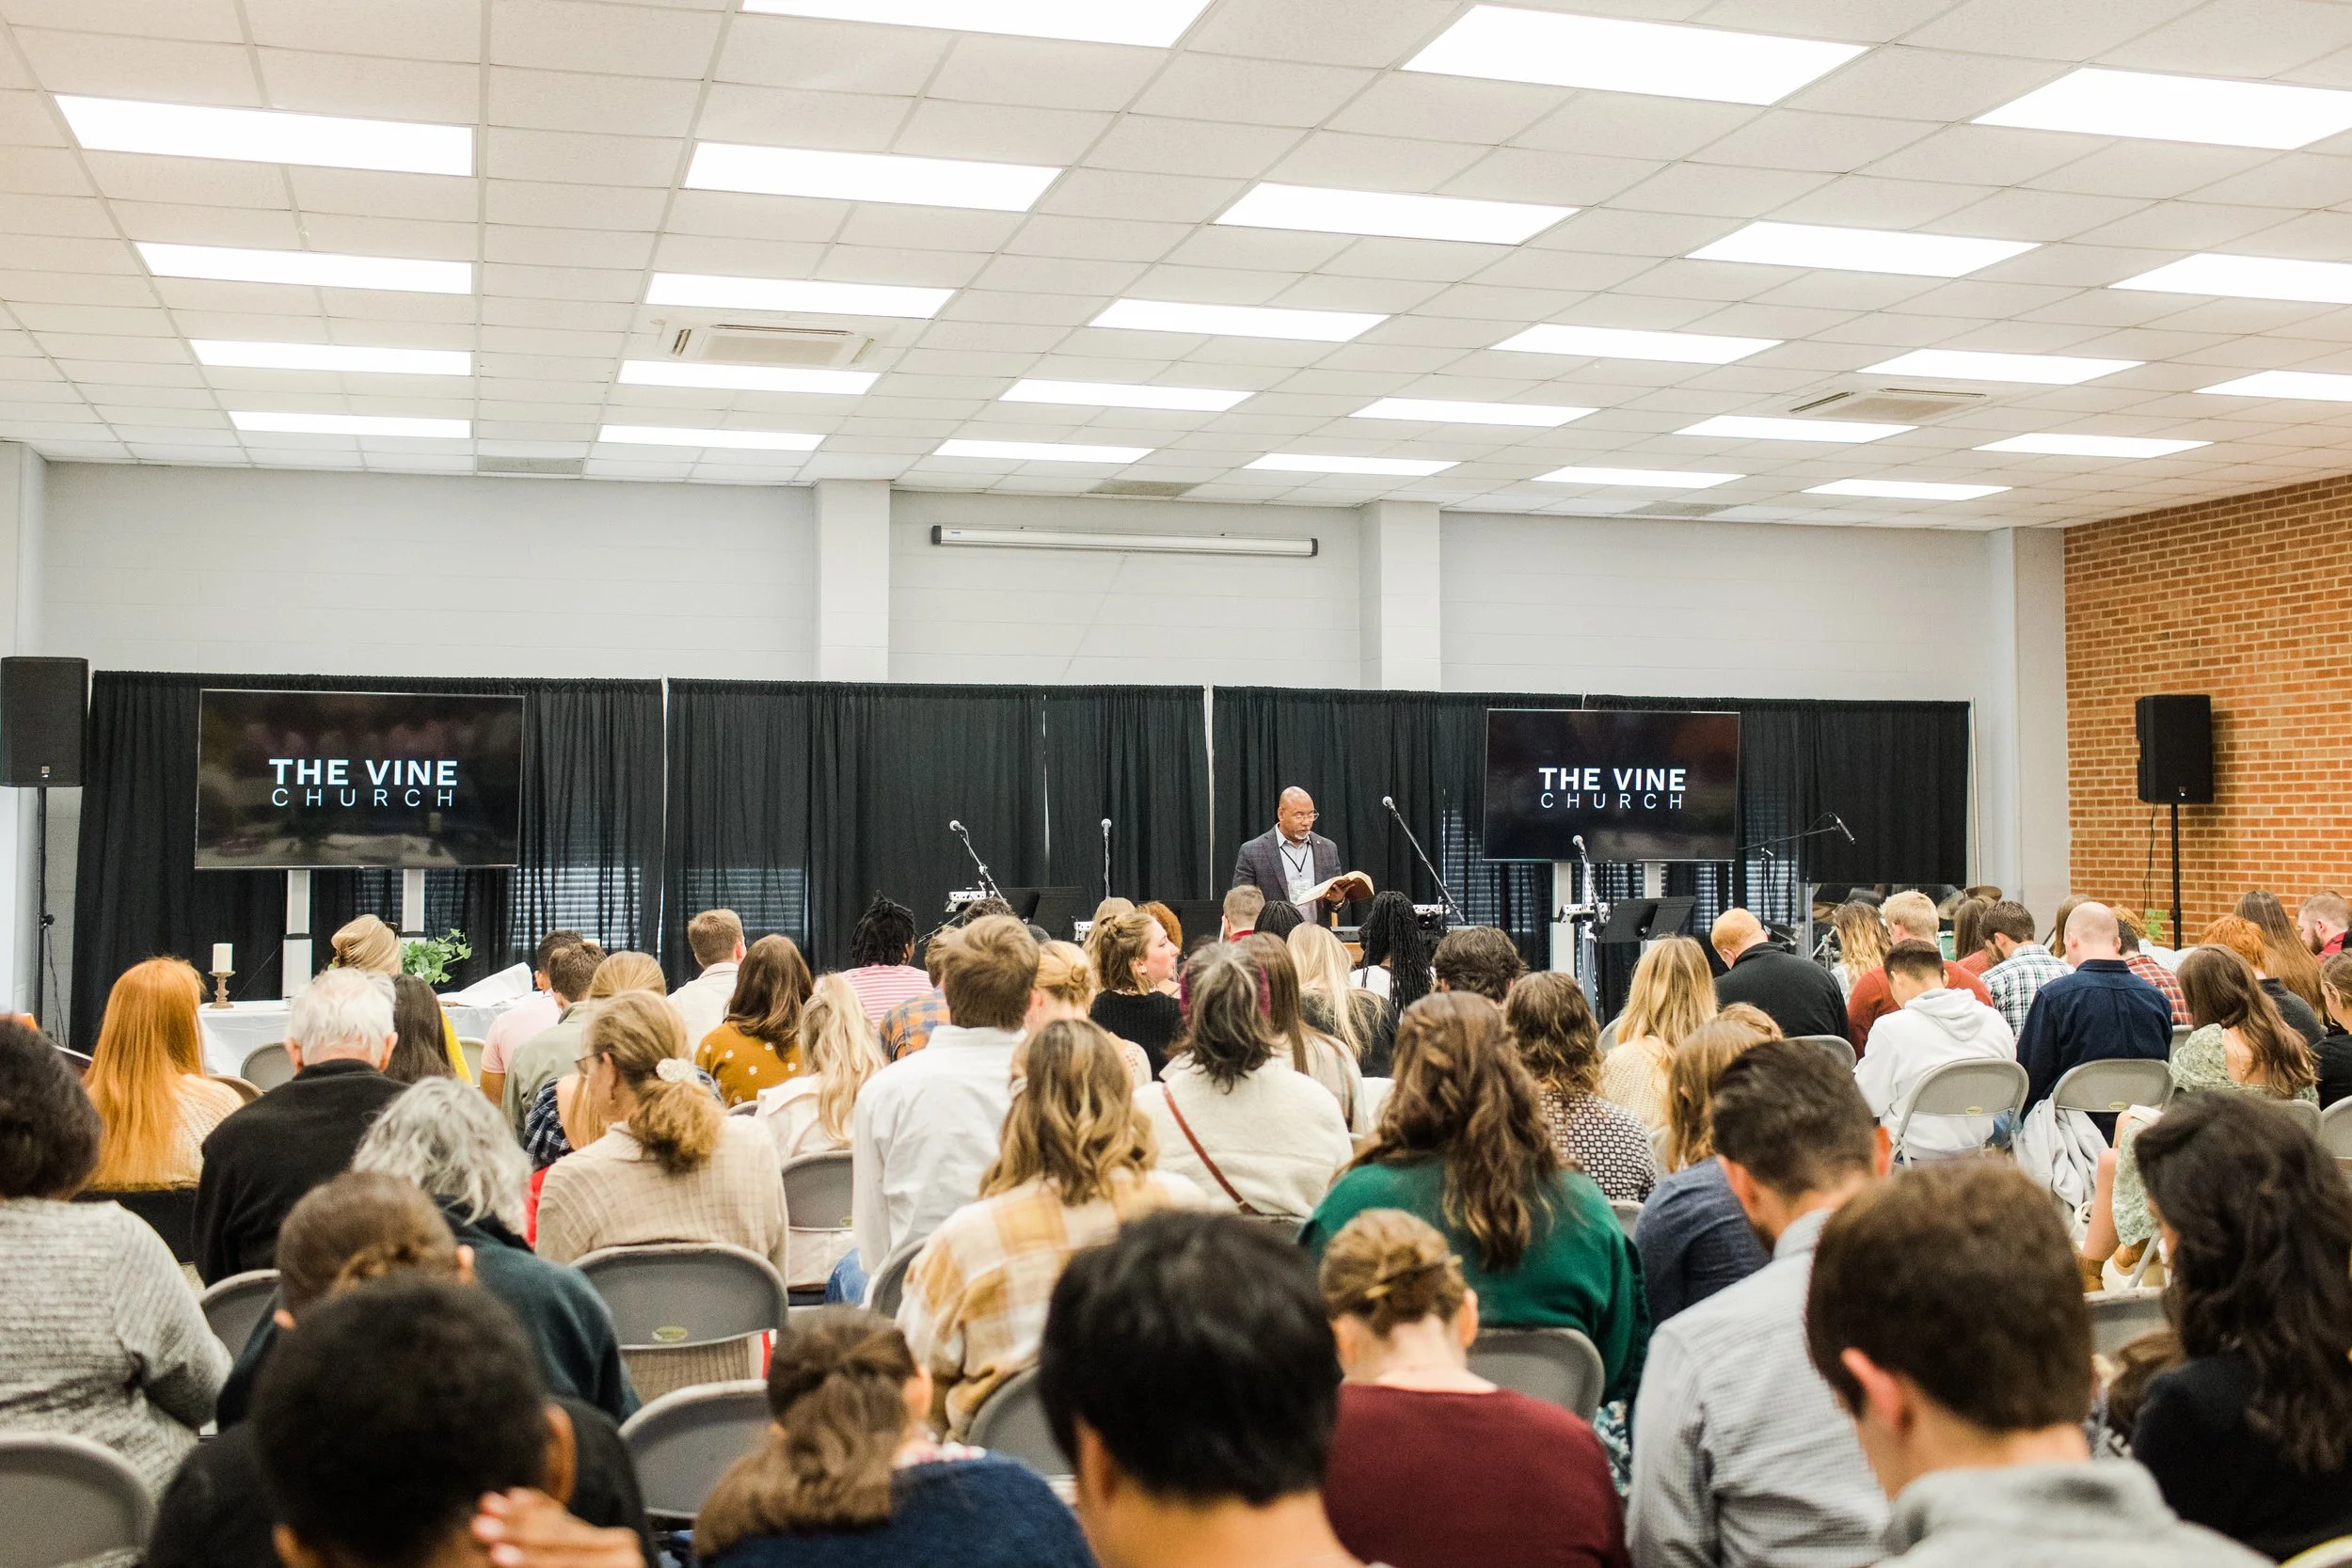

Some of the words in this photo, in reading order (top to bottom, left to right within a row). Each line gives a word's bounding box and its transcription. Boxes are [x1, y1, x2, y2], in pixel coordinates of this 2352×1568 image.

[269, 758, 349, 785] THE
[365, 760, 458, 786] VINE
[1538, 768, 1601, 791] THE
[1613, 768, 1687, 792] VINE
[271, 787, 453, 807] CHURCH
[1540, 792, 1683, 810] CHURCH
